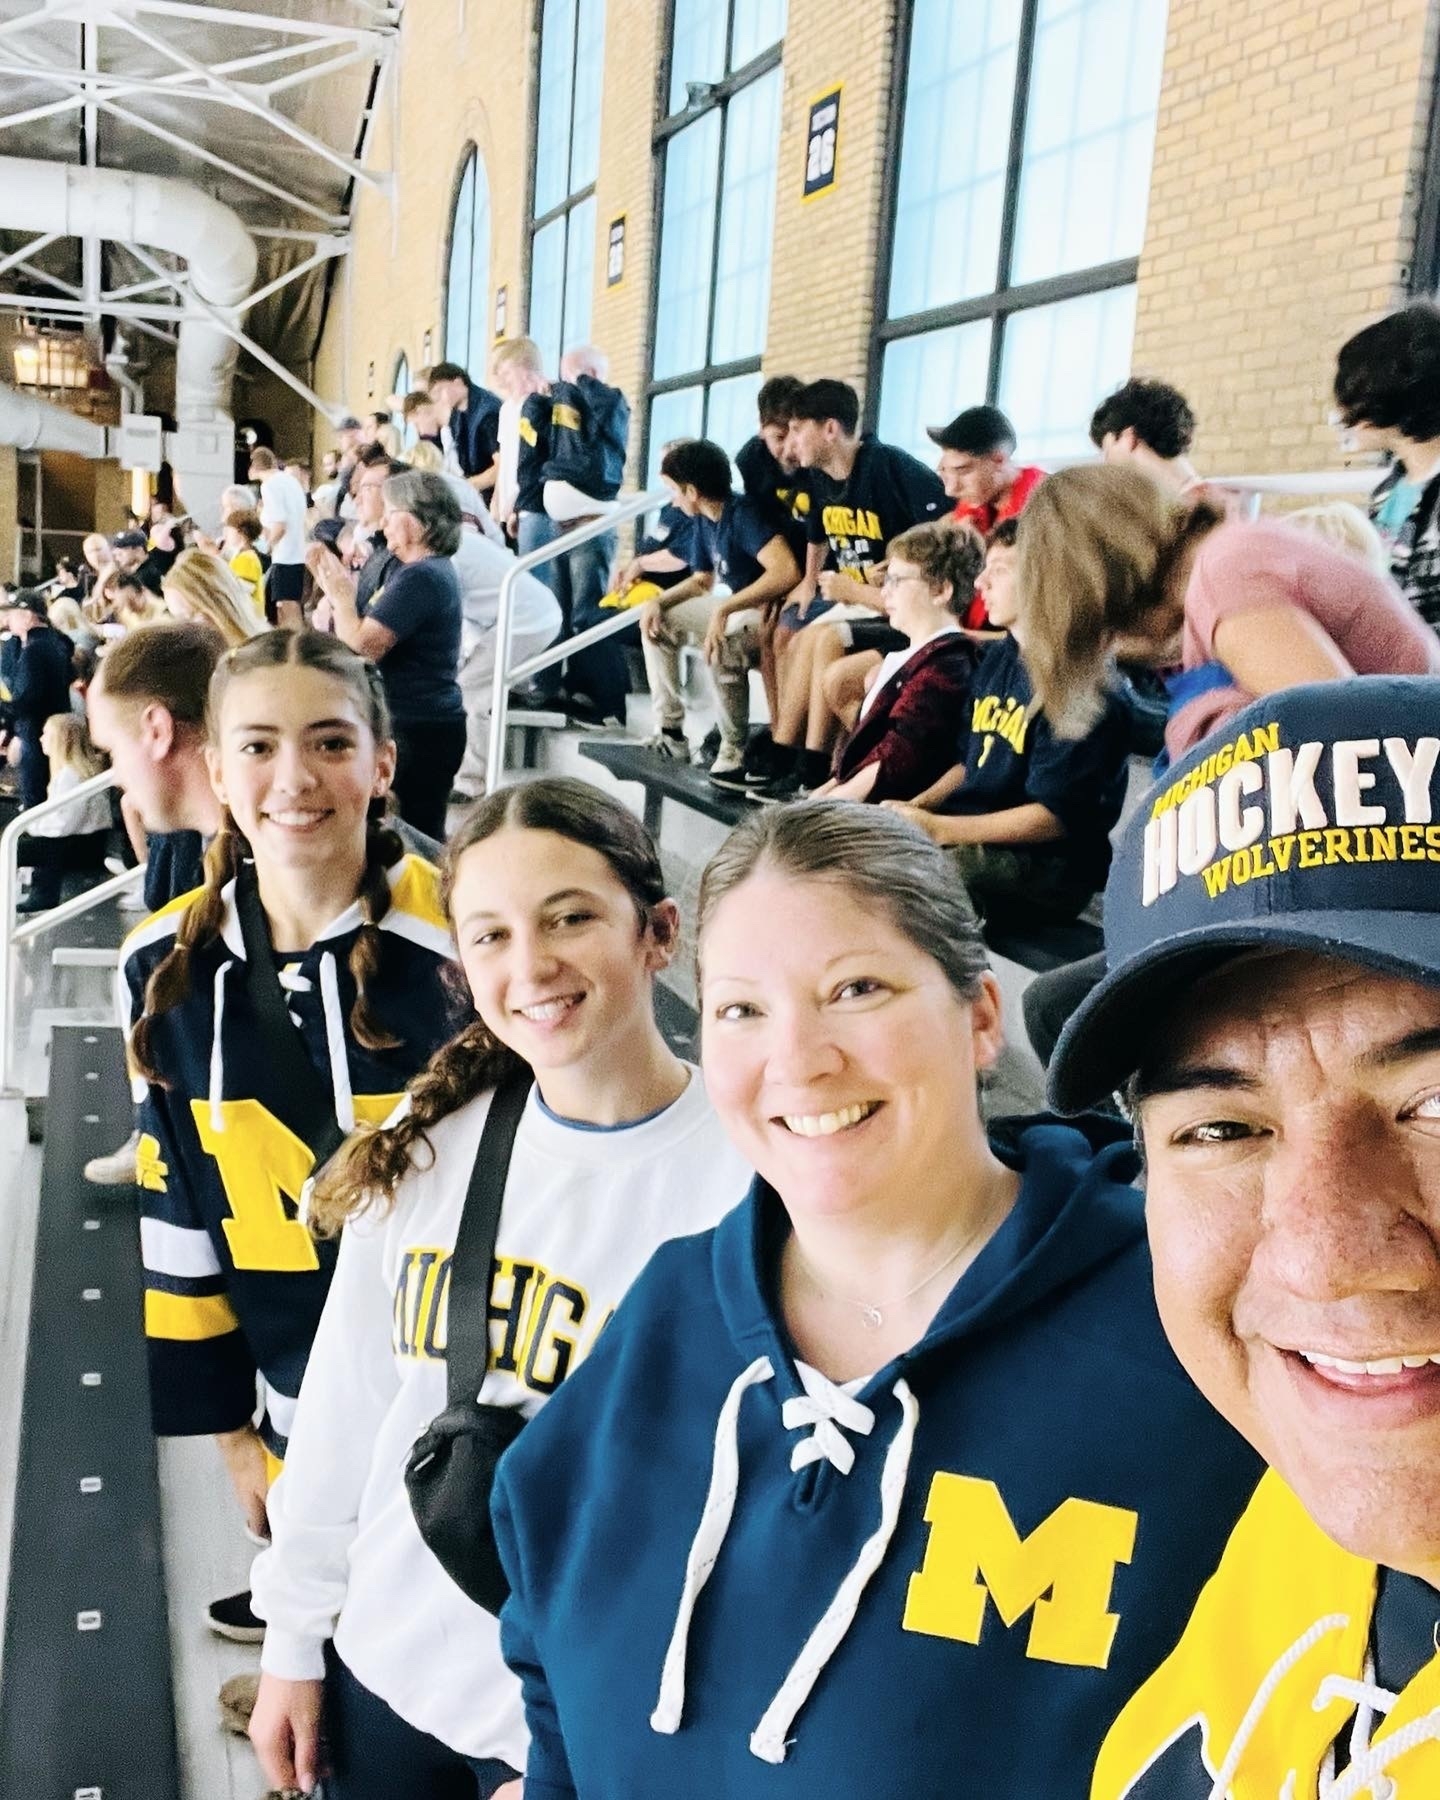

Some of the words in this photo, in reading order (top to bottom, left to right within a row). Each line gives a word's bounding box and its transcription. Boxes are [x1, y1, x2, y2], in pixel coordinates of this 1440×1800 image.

[1142, 736, 1440, 907] HOCKEY
[1152, 722, 1280, 819] MICHIGAN
[1202, 824, 1440, 898] WOLVERINES
[902, 1470, 1138, 1670] M
